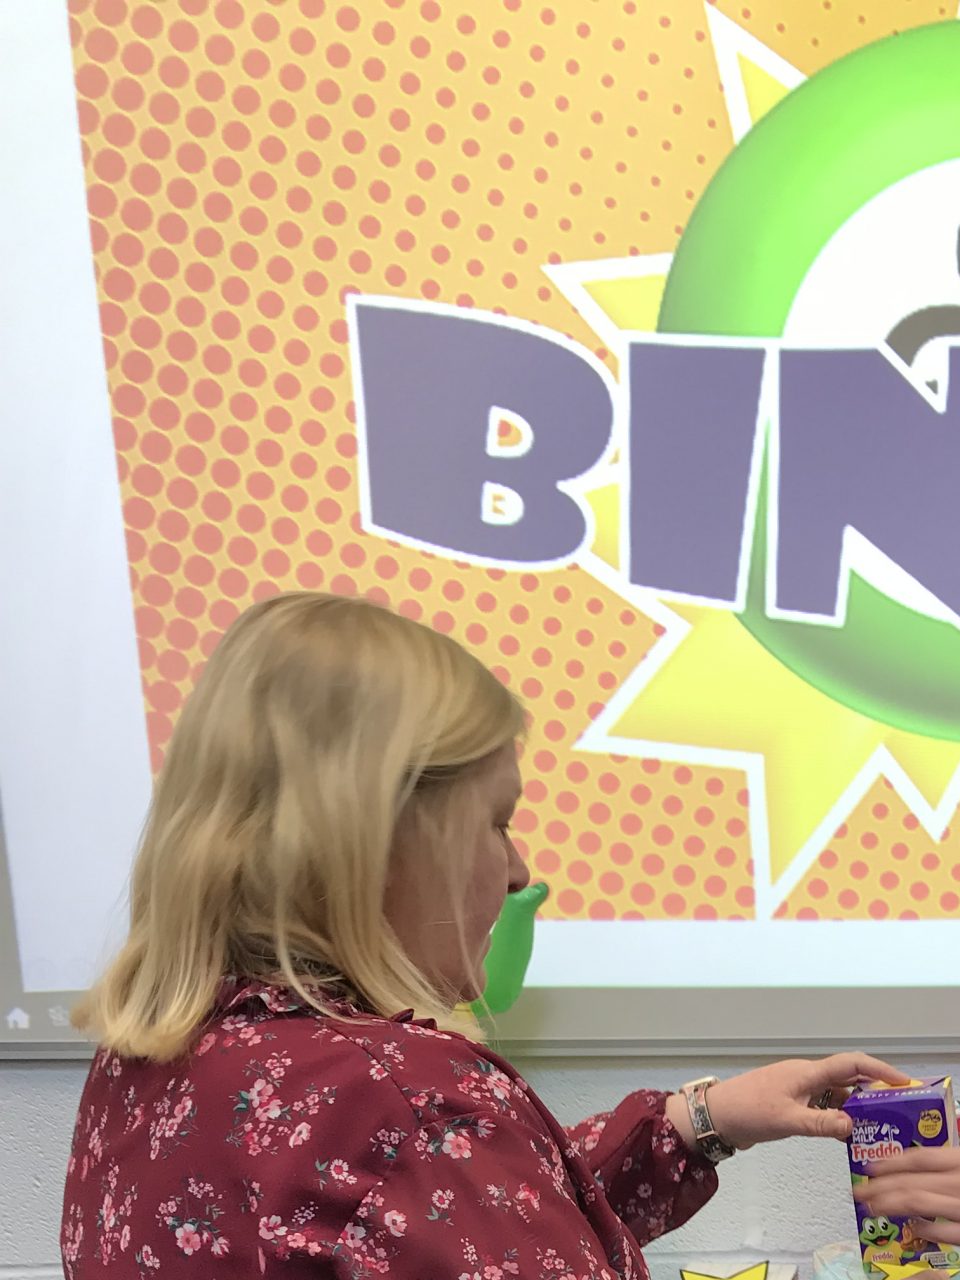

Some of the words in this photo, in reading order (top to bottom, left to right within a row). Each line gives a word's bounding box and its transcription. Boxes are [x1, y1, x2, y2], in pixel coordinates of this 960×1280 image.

[852, 1124, 880, 1136] DAIRY
[853, 1133, 877, 1145] MILK
[852, 1142, 901, 1161] Freddo
